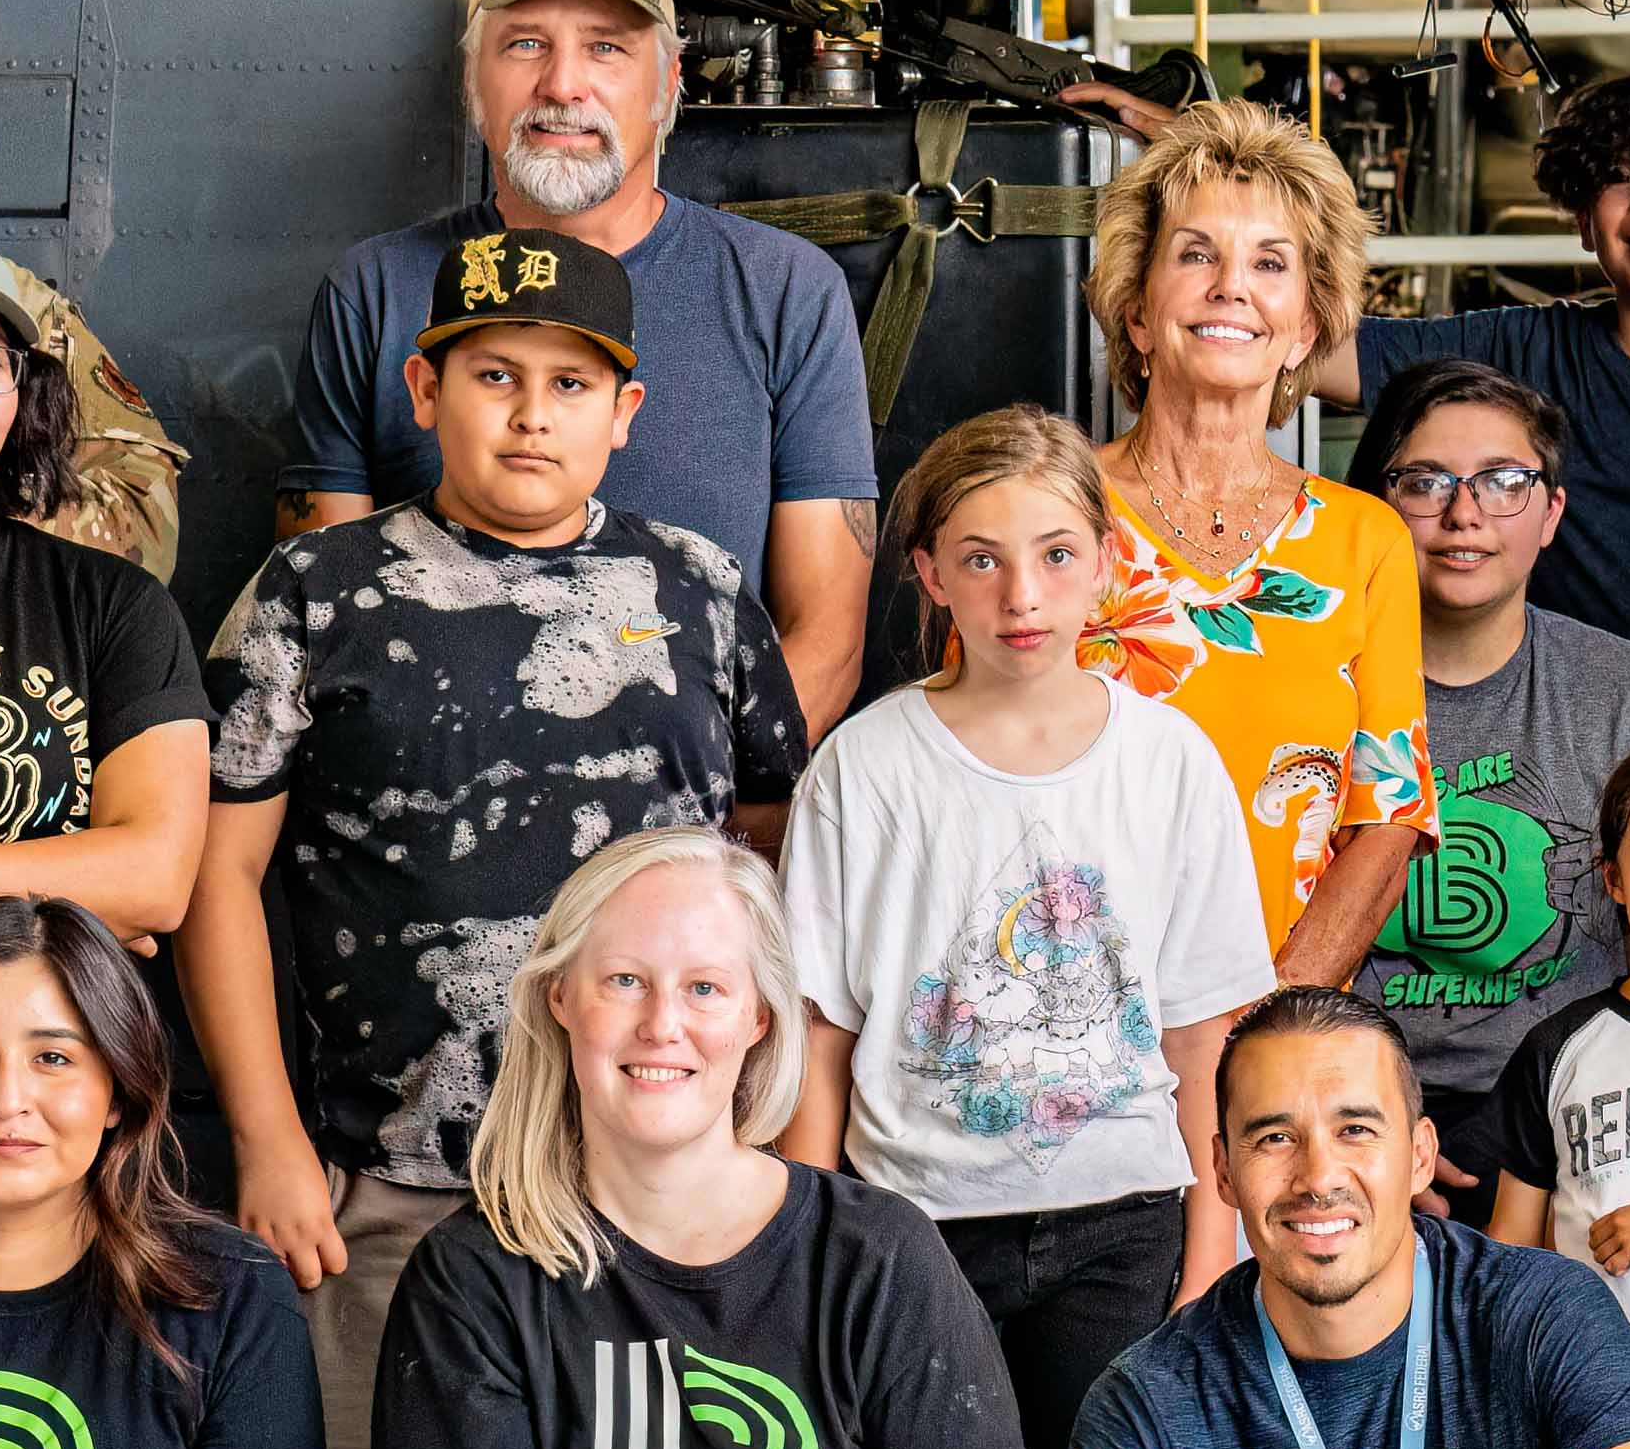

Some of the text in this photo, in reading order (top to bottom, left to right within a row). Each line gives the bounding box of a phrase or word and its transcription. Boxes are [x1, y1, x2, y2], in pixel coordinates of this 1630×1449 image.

[514, 245, 560, 295] D
[1456, 750, 1516, 798] ARE
[1412, 1344, 1429, 1418] ASRC FEDERAL
